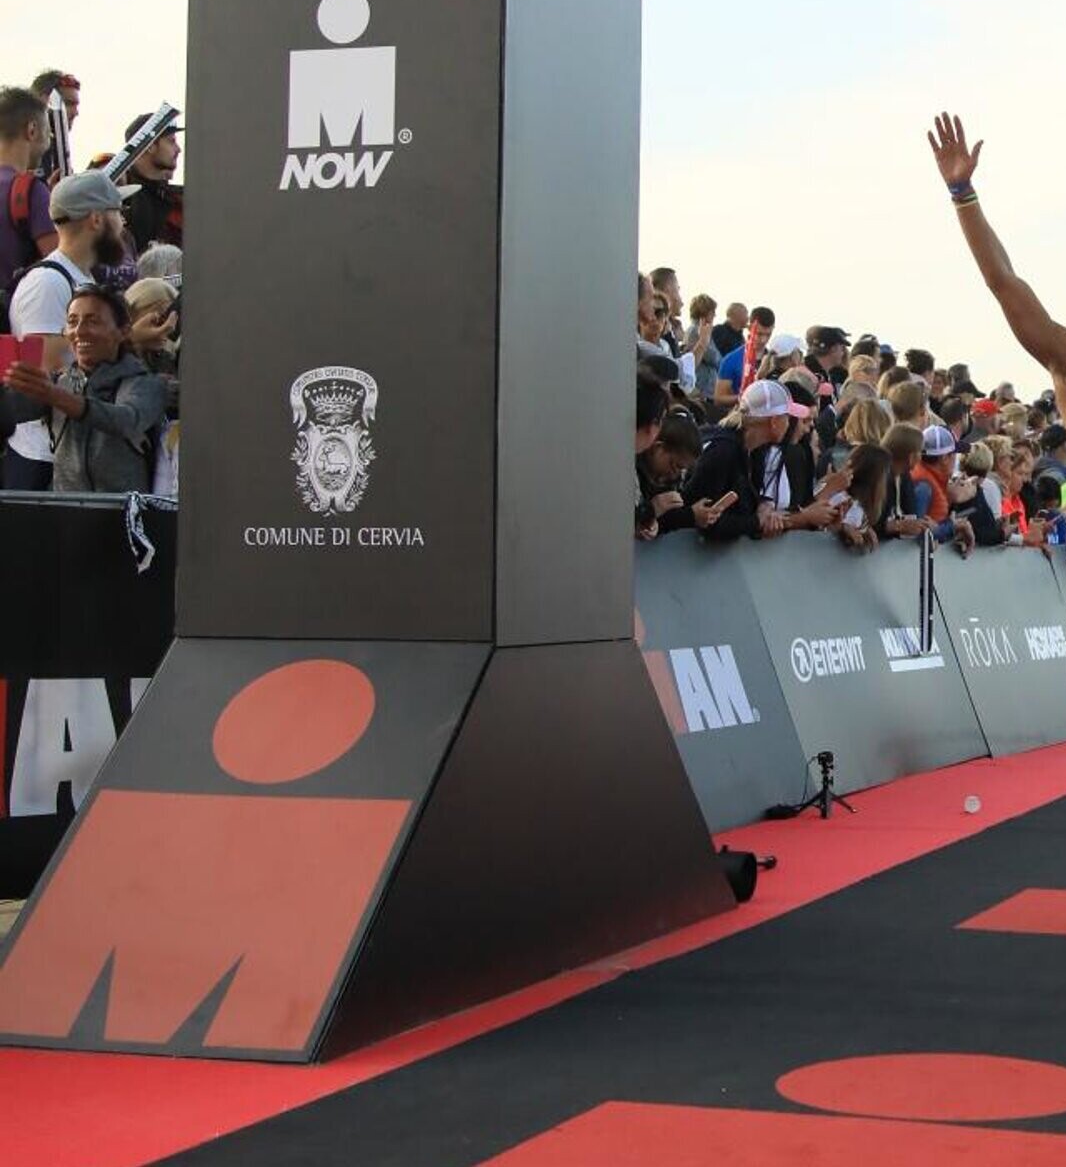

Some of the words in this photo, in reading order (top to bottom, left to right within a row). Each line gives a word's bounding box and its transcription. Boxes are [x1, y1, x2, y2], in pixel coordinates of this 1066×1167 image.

[279, 150, 393, 190] NOW
[244, 527, 326, 546] COMUNE
[332, 527, 350, 546] DI
[357, 527, 425, 546] CERVIA
[811, 636, 866, 675] ENERVIT
